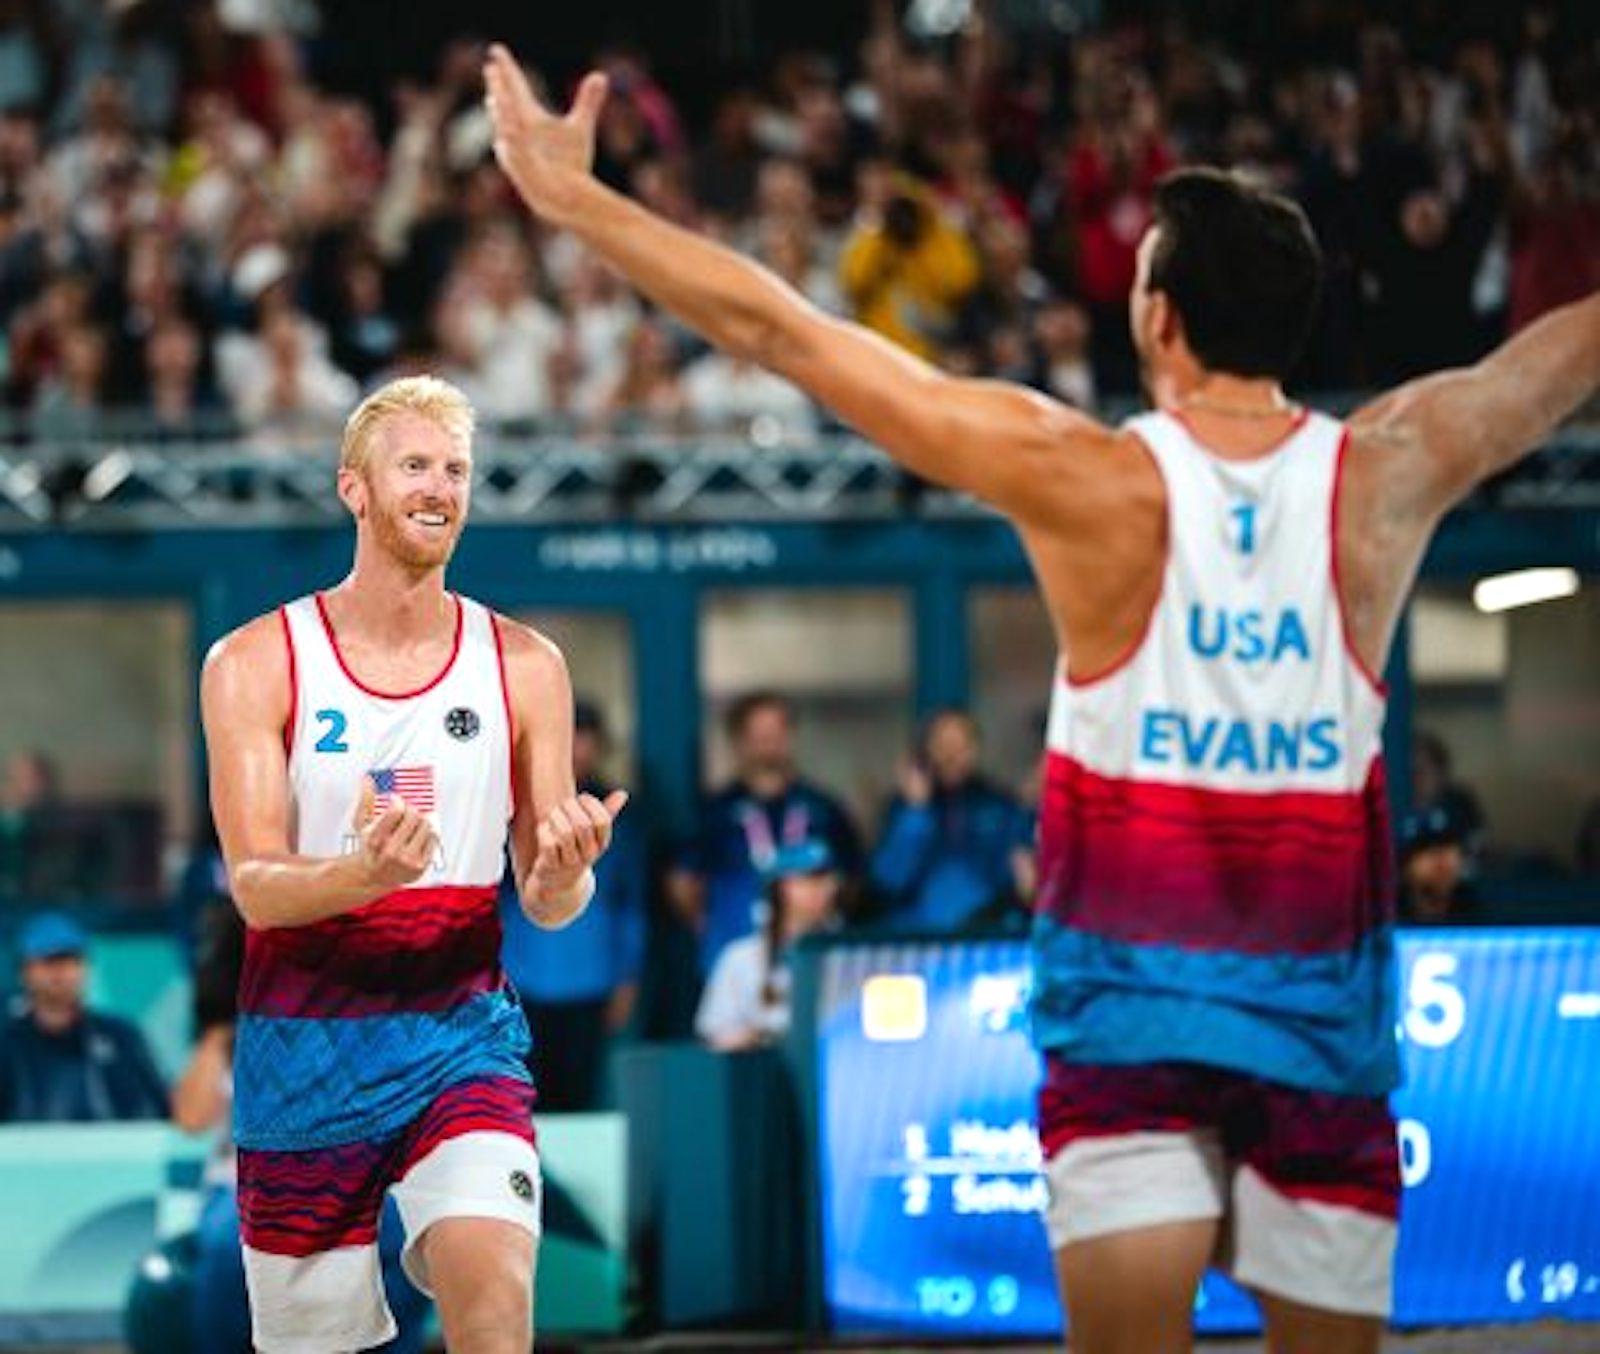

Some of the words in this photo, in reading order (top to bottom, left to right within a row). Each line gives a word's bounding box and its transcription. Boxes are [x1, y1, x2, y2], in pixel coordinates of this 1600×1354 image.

[1231, 504, 1256, 554] 1
[1188, 603, 1311, 662] USA
[314, 708, 349, 753] 2
[1140, 709, 1342, 773] EVANS
[1395, 953, 1466, 1048] 5
